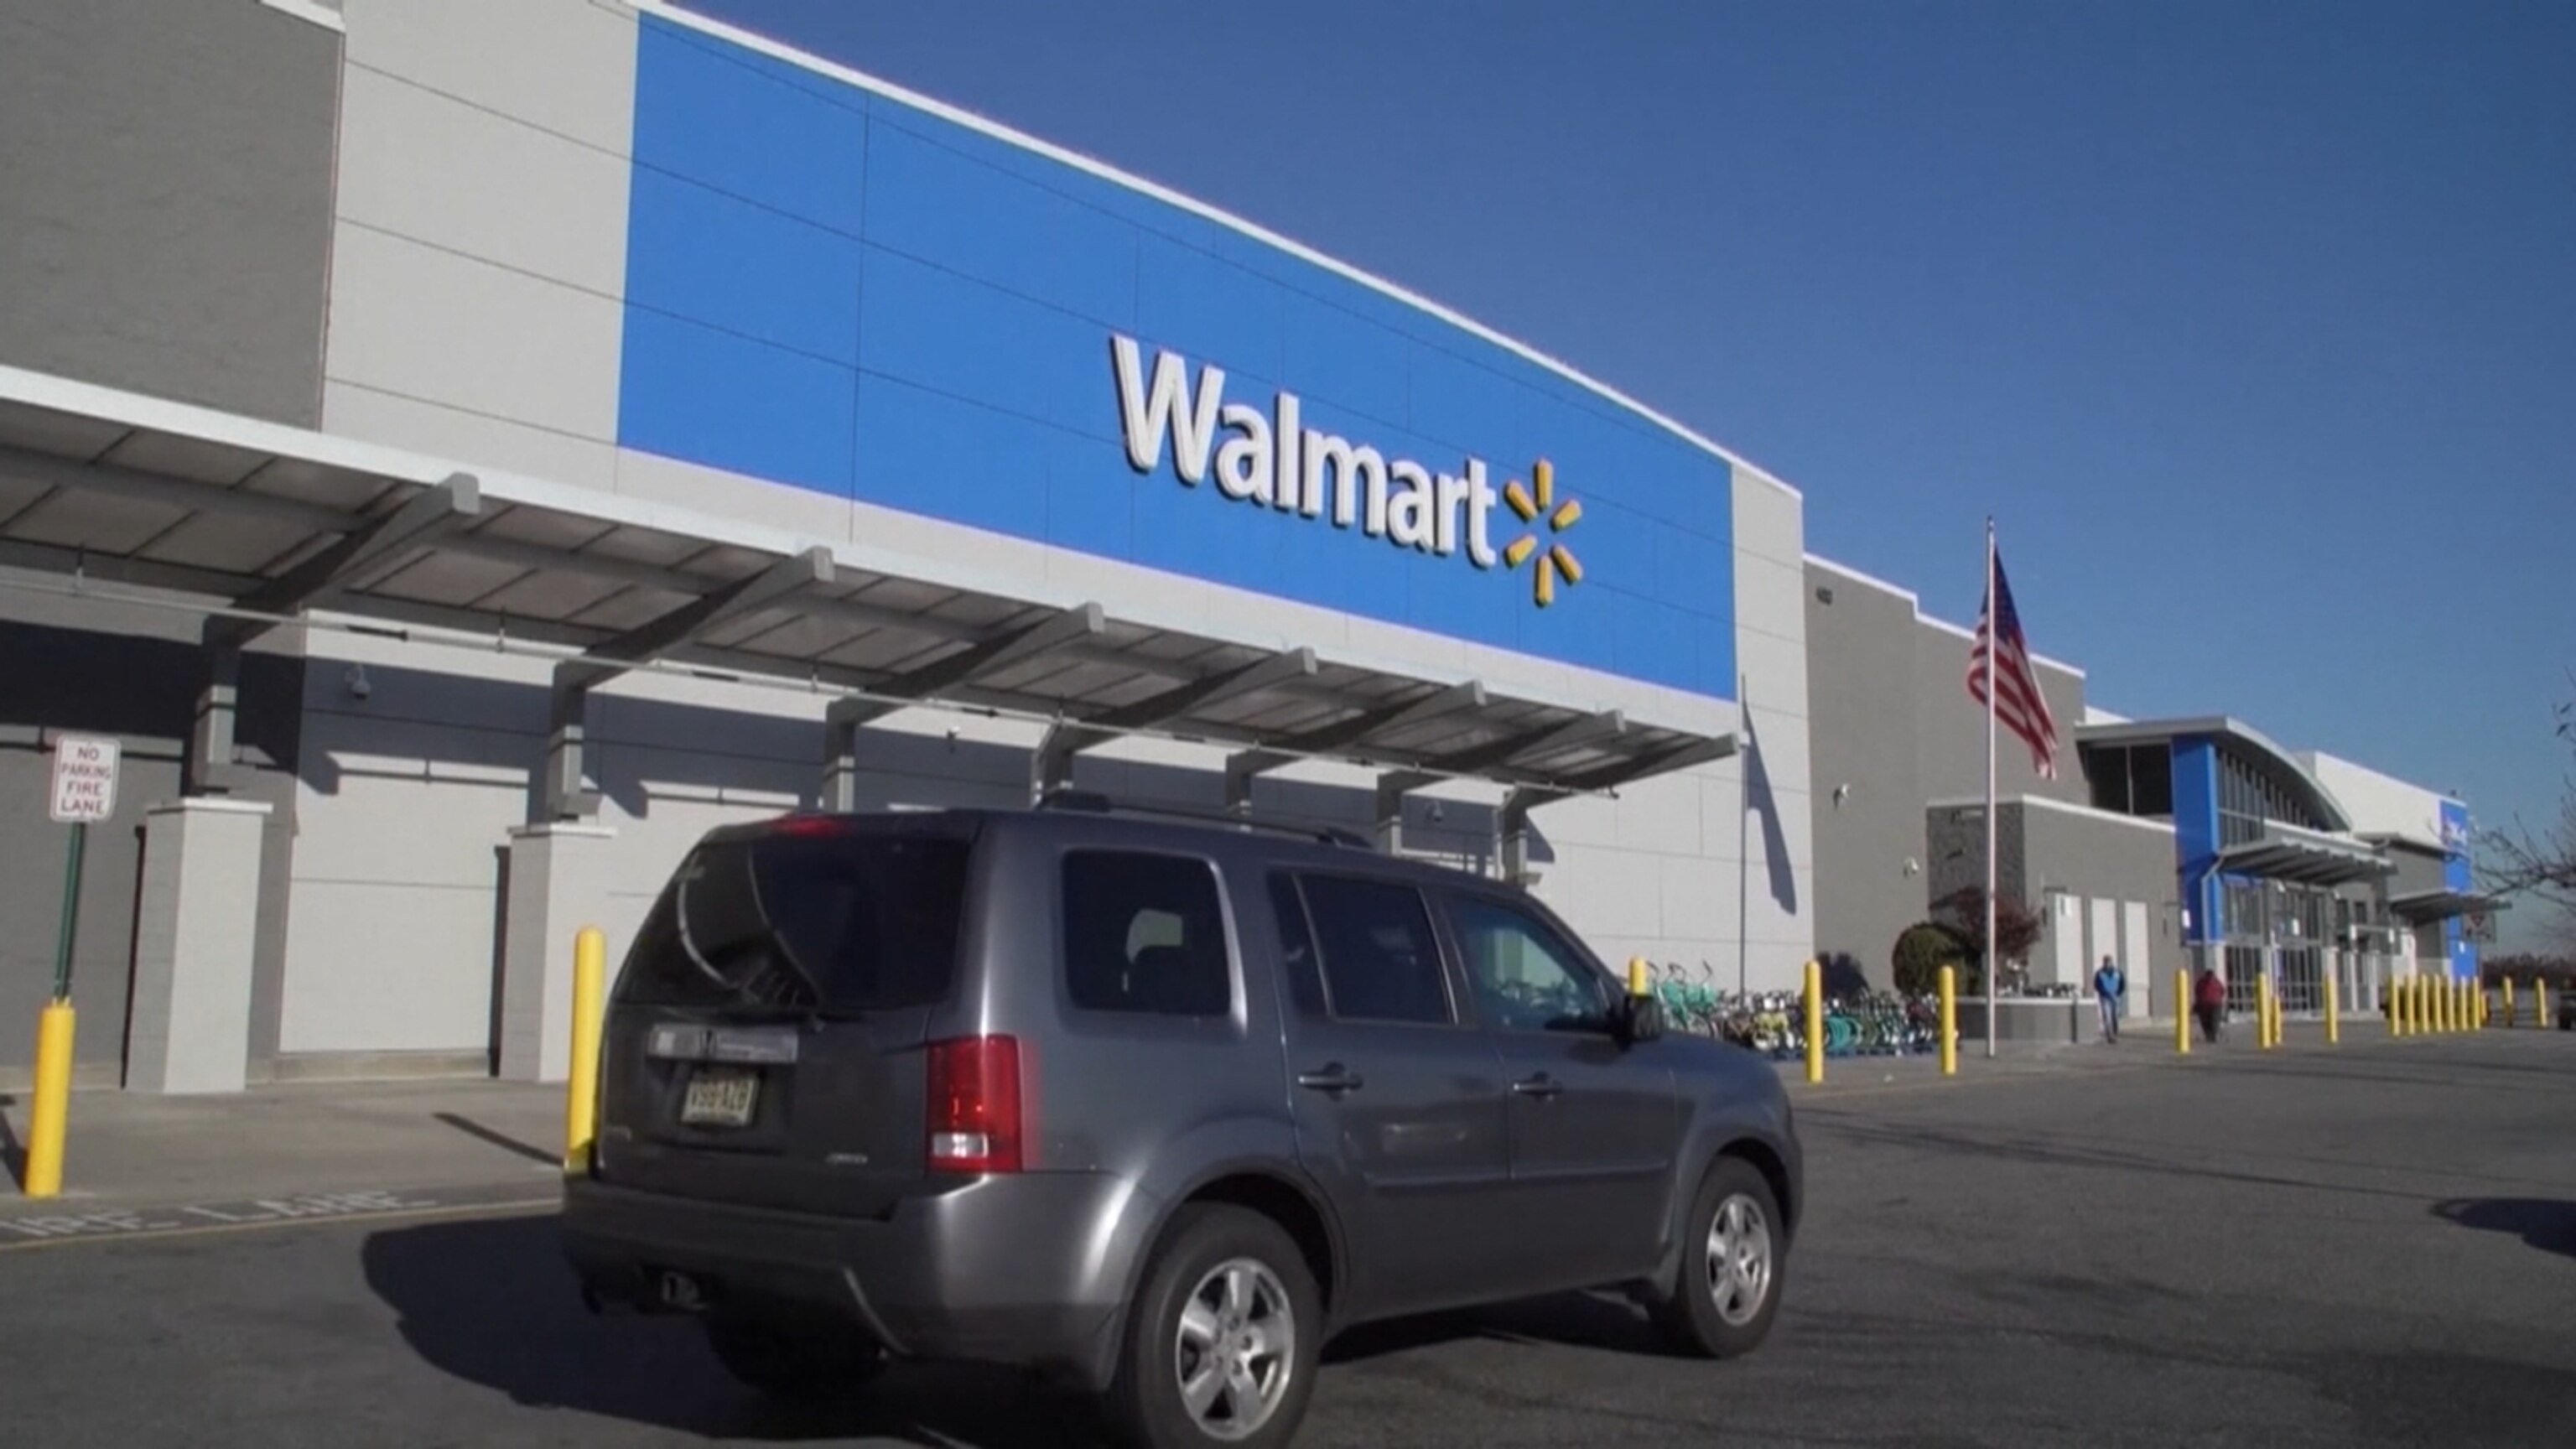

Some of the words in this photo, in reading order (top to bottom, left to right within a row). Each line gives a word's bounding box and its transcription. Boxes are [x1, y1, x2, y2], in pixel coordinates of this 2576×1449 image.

[1110, 334, 1497, 569] Walmart
[77, 746, 100, 761] NO
[60, 762, 112, 780] PARKING
[66, 781, 103, 796] FIRE
[60, 797, 106, 814] LANE
